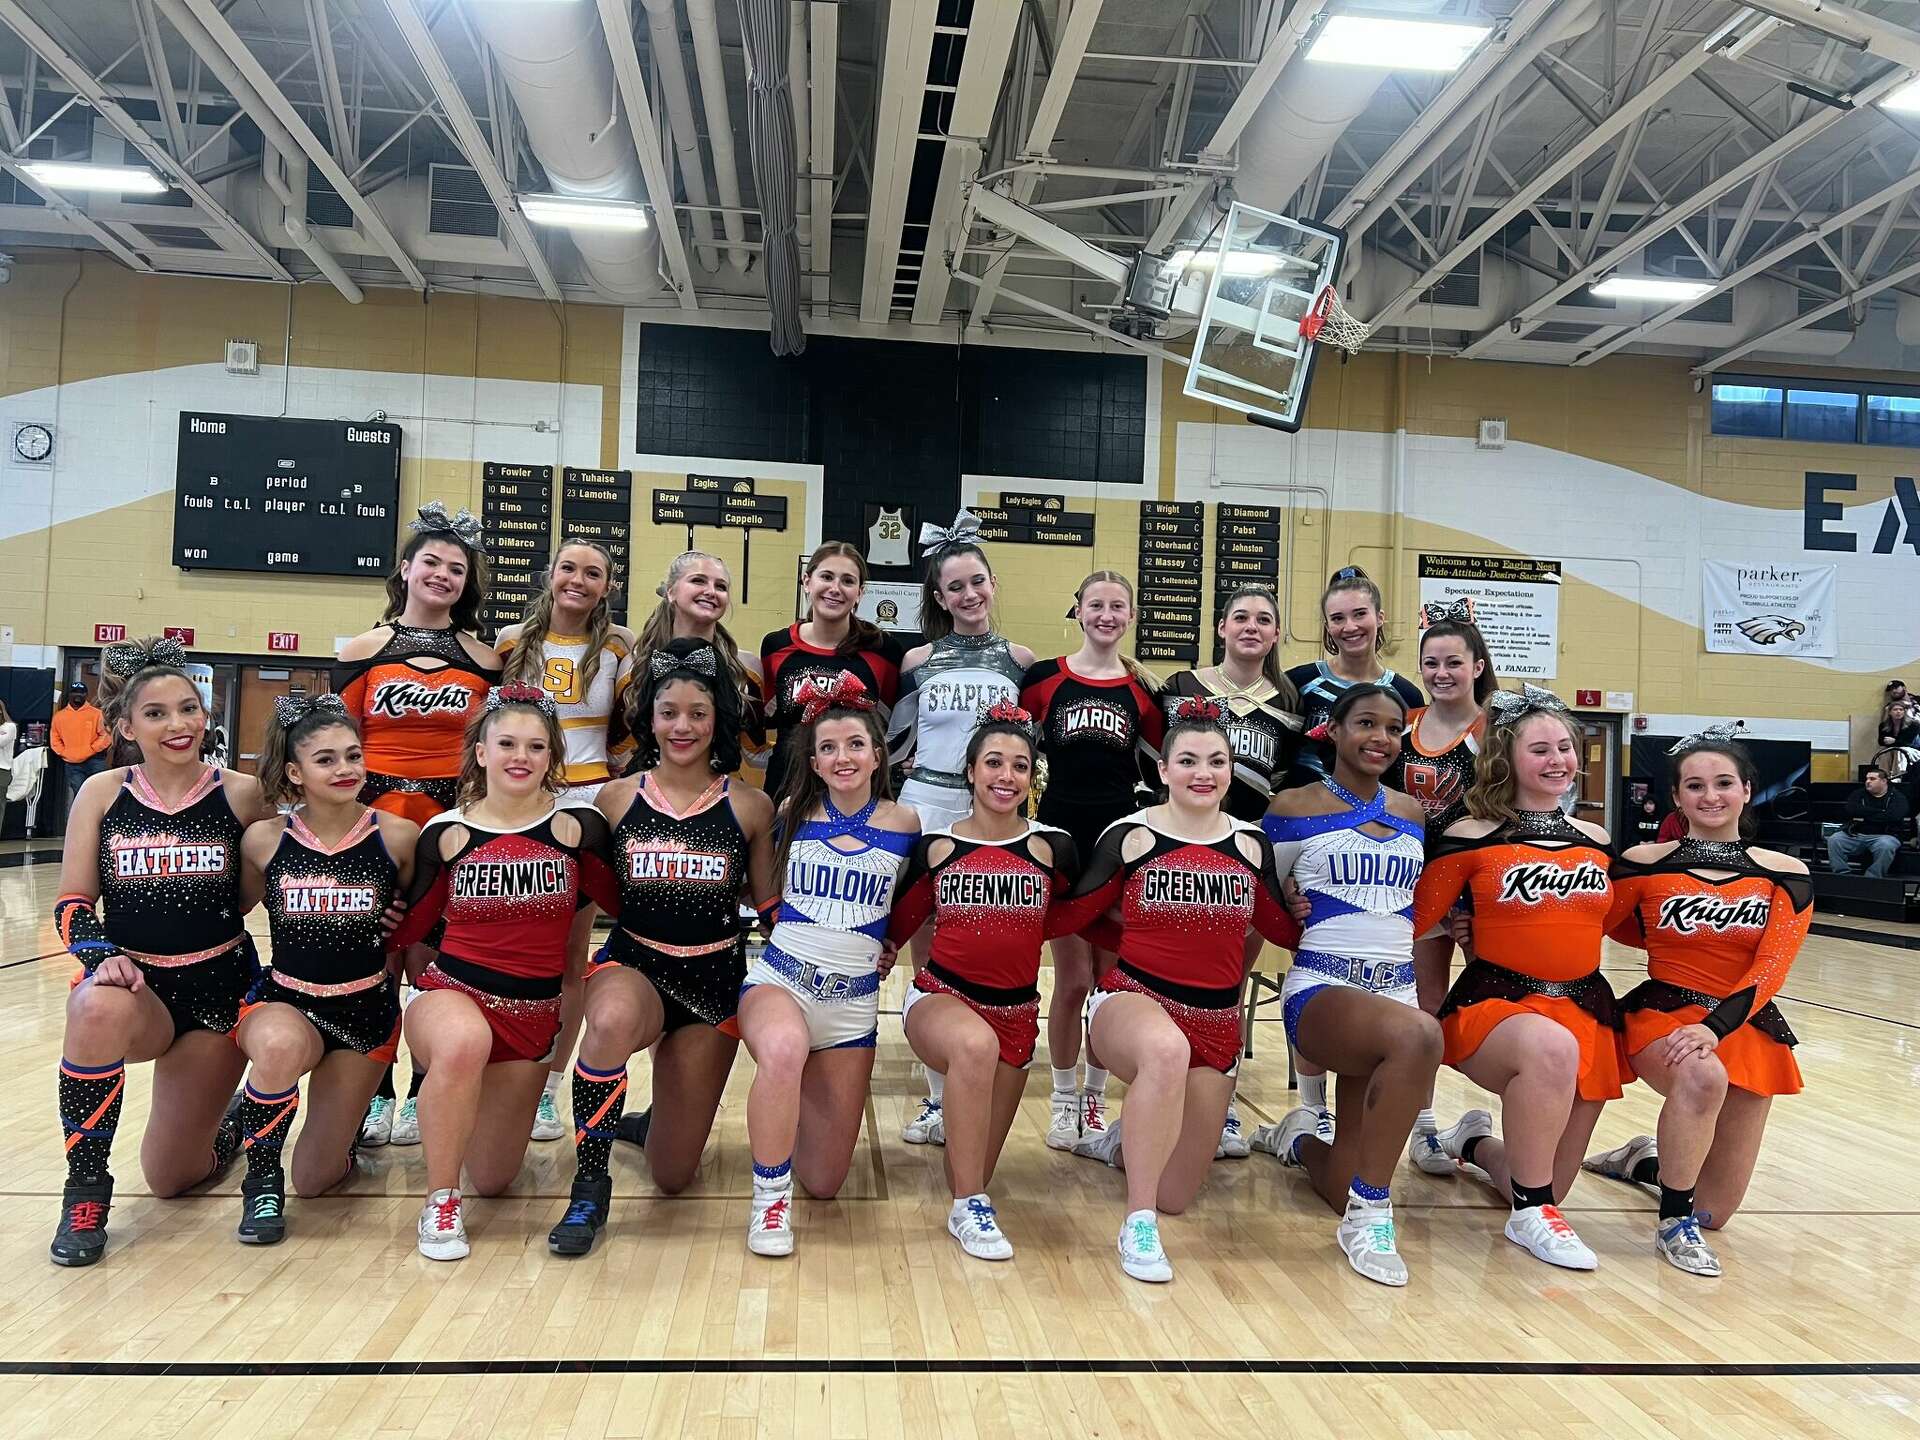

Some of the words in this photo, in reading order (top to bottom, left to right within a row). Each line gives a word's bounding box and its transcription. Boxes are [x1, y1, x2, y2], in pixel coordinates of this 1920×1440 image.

[190, 418, 226, 434] Home
[347, 427, 391, 444] Guests
[488, 466, 494, 474] 5
[501, 466, 532, 477] Fowler
[543, 469, 549, 478] C
[210, 476, 219, 486] B
[266, 476, 307, 490] period
[569, 473, 576, 482] 12
[581, 474, 615, 483] Tuhaise
[354, 484, 362, 493] B
[694, 478, 719, 490] Eagles
[488, 485, 496, 493] 10
[500, 485, 518, 495] Bull
[542, 488, 548, 496] C
[566, 489, 576, 498] 23
[579, 490, 618, 500] Lamothe
[660, 493, 680, 503] Bray
[726, 497, 756, 507] Landin
[1006, 497, 1020, 506] Lady
[1022, 497, 1042, 506] Eagles
[184, 495, 214, 509] fouls
[264, 498, 306, 513] player
[357, 504, 386, 517] fouls
[488, 502, 494, 510] 11
[499, 502, 522, 512] Elmo
[542, 504, 548, 513] C
[1156, 505, 1180, 515] Wright
[1194, 506, 1200, 514] C
[658, 508, 684, 518] Smith
[973, 510, 1008, 520] Tobitsch
[1222, 508, 1231, 516] 33
[1234, 508, 1270, 518] Diamond
[725, 514, 763, 525] Cappello
[1037, 514, 1057, 524] Kelly
[486, 520, 492, 528] 2
[498, 520, 538, 530] Johnston
[540, 522, 546, 531] C
[568, 523, 601, 534] Dobson
[611, 527, 626, 536] Mgr
[879, 521, 901, 539] 32
[1156, 523, 1178, 534] Foley
[1194, 524, 1200, 532] C
[1233, 526, 1256, 535] Pabst
[975, 528, 1008, 538] oughlin
[1036, 531, 1081, 542] Trommelen
[486, 538, 495, 546] 24
[498, 537, 535, 547] DiMarco
[1144, 540, 1152, 548] 24
[1155, 541, 1191, 550] Oberhand
[1193, 542, 1199, 550] C
[610, 545, 625, 555] Mgr
[1232, 544, 1263, 553] Johnston
[184, 548, 208, 559] won
[267, 551, 299, 564] game
[357, 556, 381, 567] won
[486, 555, 495, 564] 20
[498, 556, 531, 566] Banner
[1144, 558, 1153, 566] 32
[1155, 558, 1186, 569] Massey
[1193, 559, 1198, 567] C
[1220, 561, 1225, 569] 5
[1232, 561, 1261, 570] Manuel
[1425, 555, 1467, 567] Welcome
[1484, 560, 1499, 568] the
[1502, 560, 1533, 572] Eagles
[497, 573, 531, 583] Randall
[1738, 565, 1802, 591] parker.
[496, 591, 527, 602] Kingan
[1445, 587, 1481, 596] Spectator
[1485, 588, 1534, 598] Expectations
[1154, 595, 1197, 603] Gruttadauria
[494, 610, 520, 620] Jones
[1153, 611, 1193, 622] Wadhams
[99, 626, 123, 641] EXIT
[1153, 630, 1195, 640] McGillicuddy
[272, 634, 296, 650] EXIT
[1152, 647, 1176, 656] Vitola
[1505, 665, 1540, 673] FANATIC
[374, 684, 470, 716] Knights
[1066, 708, 1126, 738] WARDE
[1226, 728, 1276, 768] MBULL
[109, 832, 180, 849] Danbury
[626, 836, 686, 856] Danbury
[116, 845, 226, 877] HATTERS
[631, 852, 726, 880] HATTERS
[278, 874, 338, 889] Danbury
[456, 860, 567, 898] GREENWICH
[791, 861, 891, 907] LUDLOWE
[1504, 864, 1606, 902] Knights
[939, 872, 1042, 907] GREENWICH
[1144, 868, 1250, 908] GREENWICH
[285, 887, 375, 913] HATTERS
[1660, 896, 1769, 934] Knights
[798, 961, 850, 999] LC
[1348, 957, 1395, 992] LC
